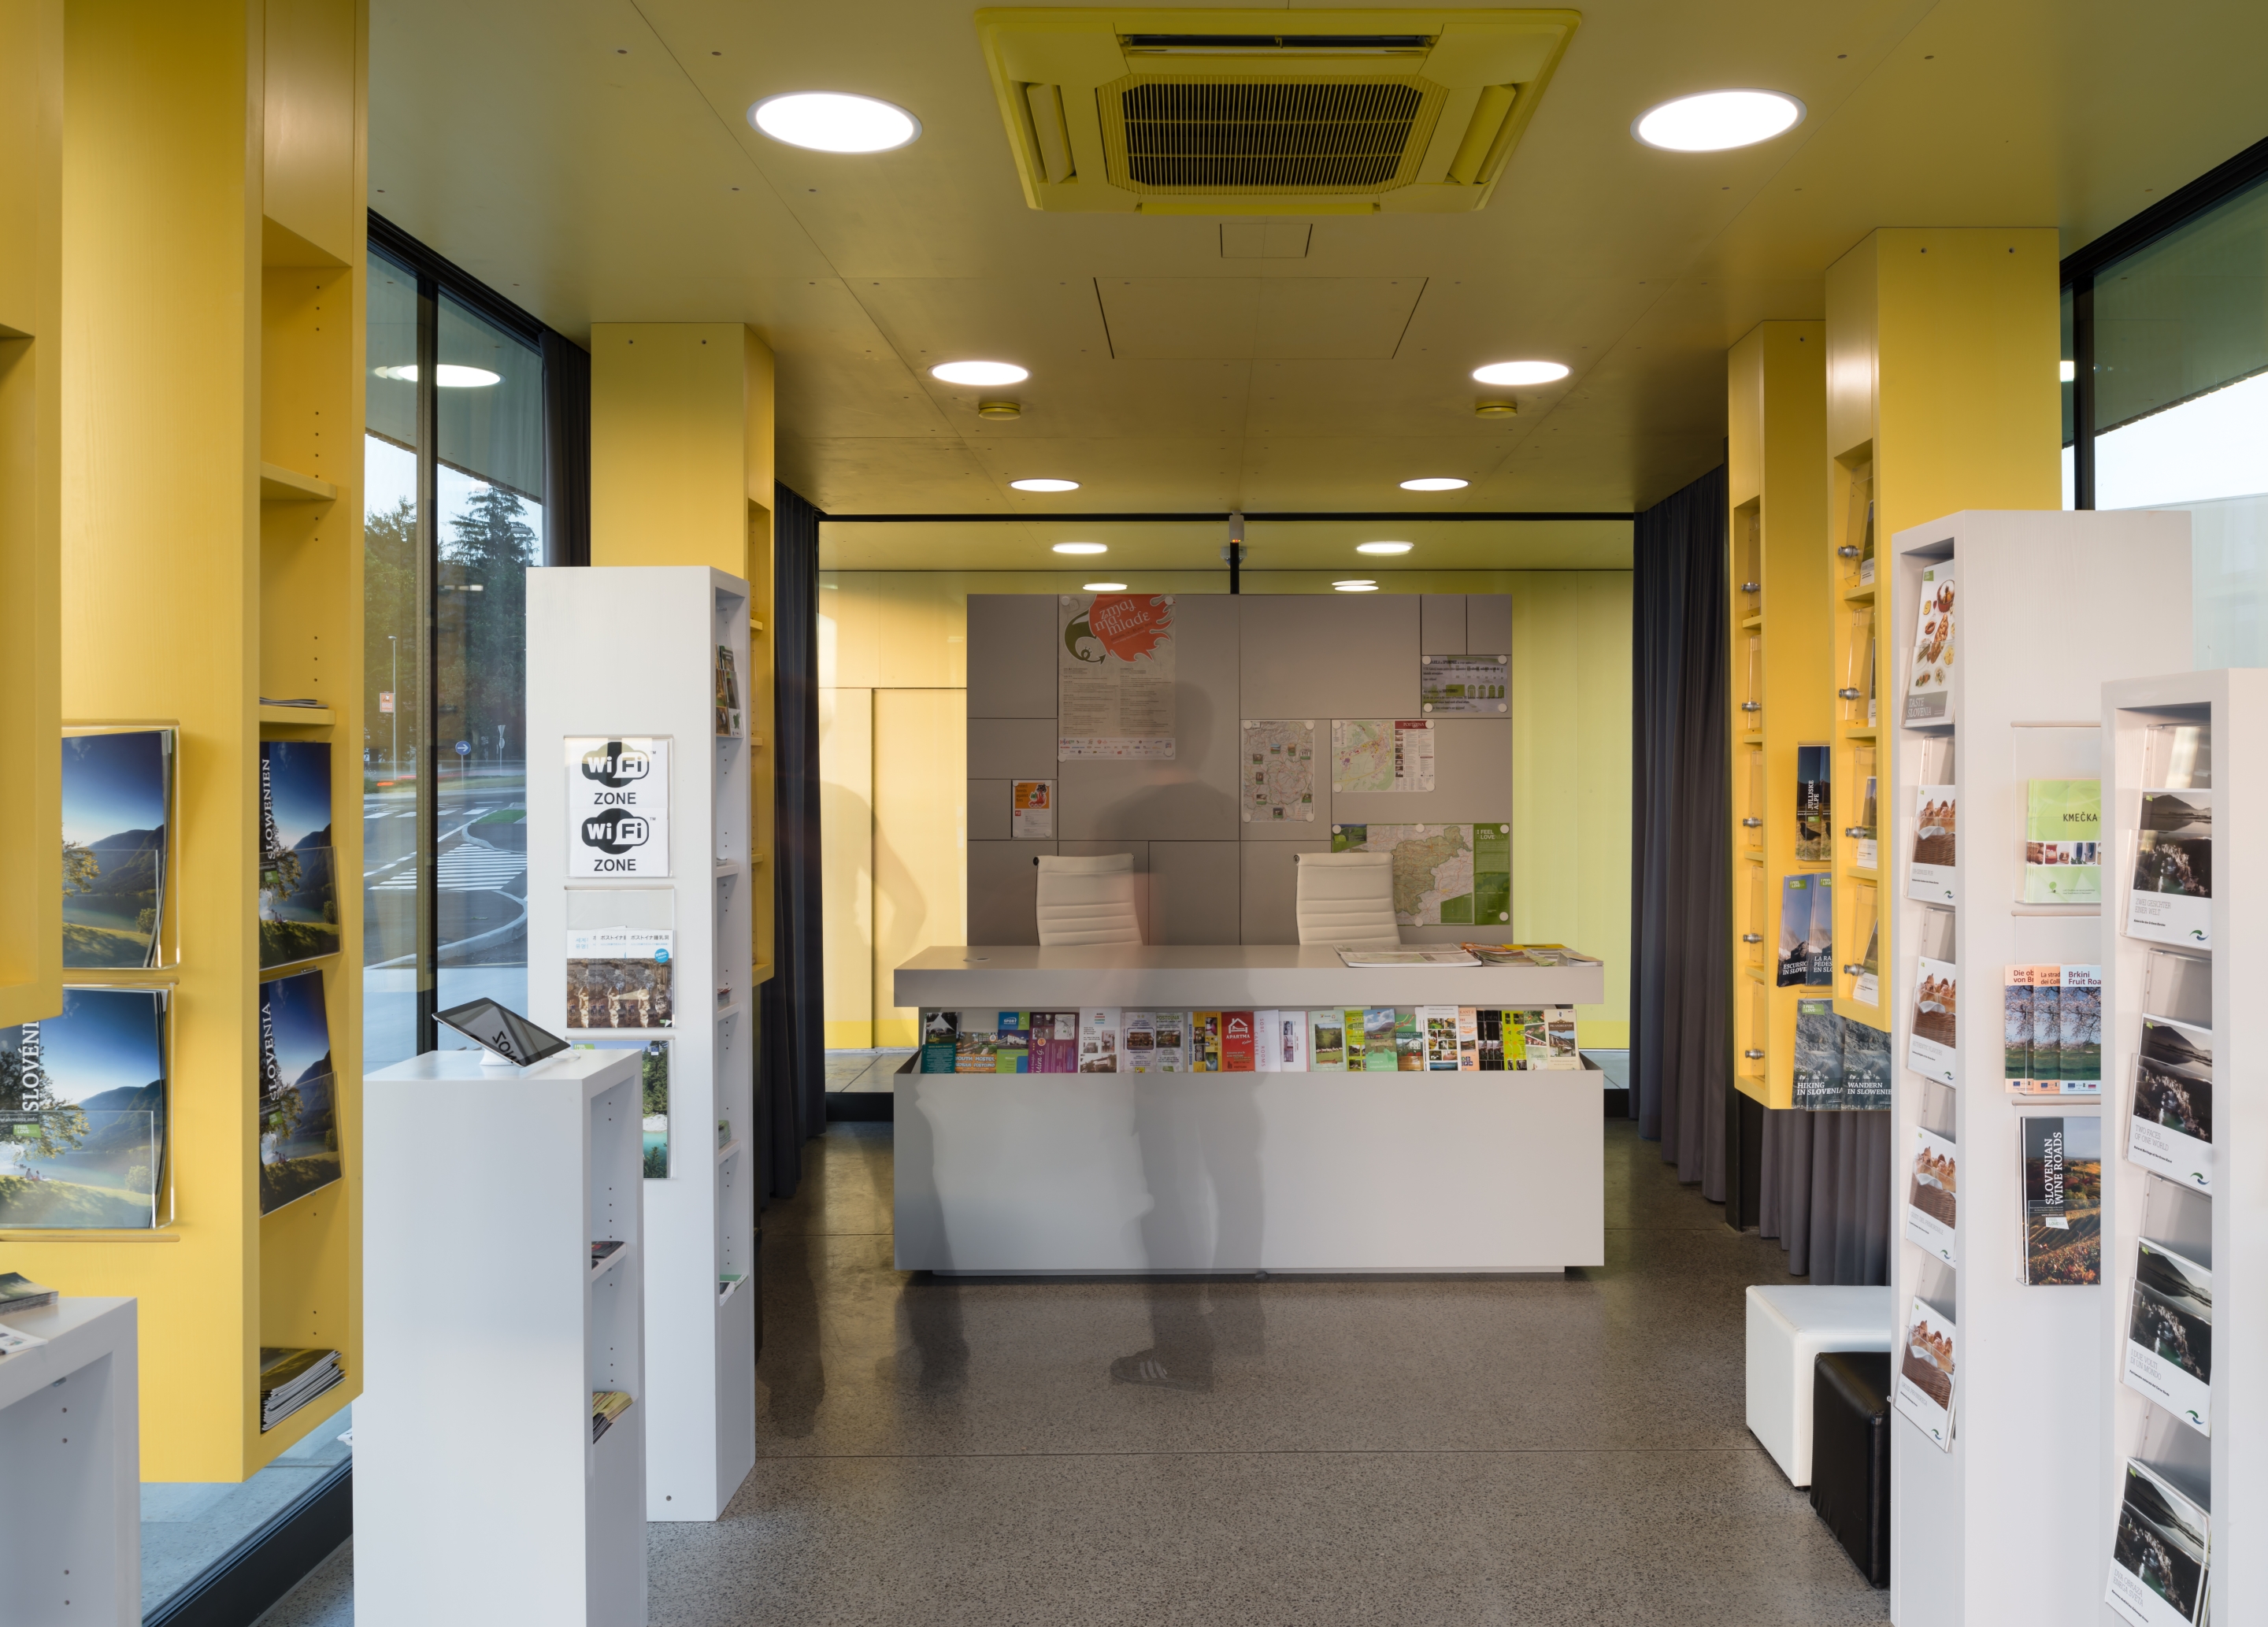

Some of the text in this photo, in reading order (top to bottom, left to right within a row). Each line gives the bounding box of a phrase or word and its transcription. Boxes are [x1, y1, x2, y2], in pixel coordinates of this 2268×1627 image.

[1909, 698, 1924, 707] TASTE
[1907, 707, 1932, 717] SLOVENIA
[594, 792, 636, 805] ZONE
[262, 758, 276, 859] SLOWENIEN
[2063, 811, 2098, 821] KMEČKA
[594, 858, 636, 871] ZONE
[2147, 899, 2171, 909] GESICHTER
[261, 1002, 280, 1101] SLOVENIA
[2136, 1125, 2161, 1140] TWO FACES
[2142, 1136, 2151, 1144] ONE
[2152, 1139, 2169, 1151] WORLD
[2044, 1138, 2054, 1205] SLOVENIAN
[2053, 1132, 2063, 1205] WINE ROADS
[2133, 1350, 2144, 1362] DUE
[2144, 1355, 2158, 1369] VOLTI
[2136, 1359, 2144, 1369] UN
[2144, 1364, 2162, 1380] MONDO
